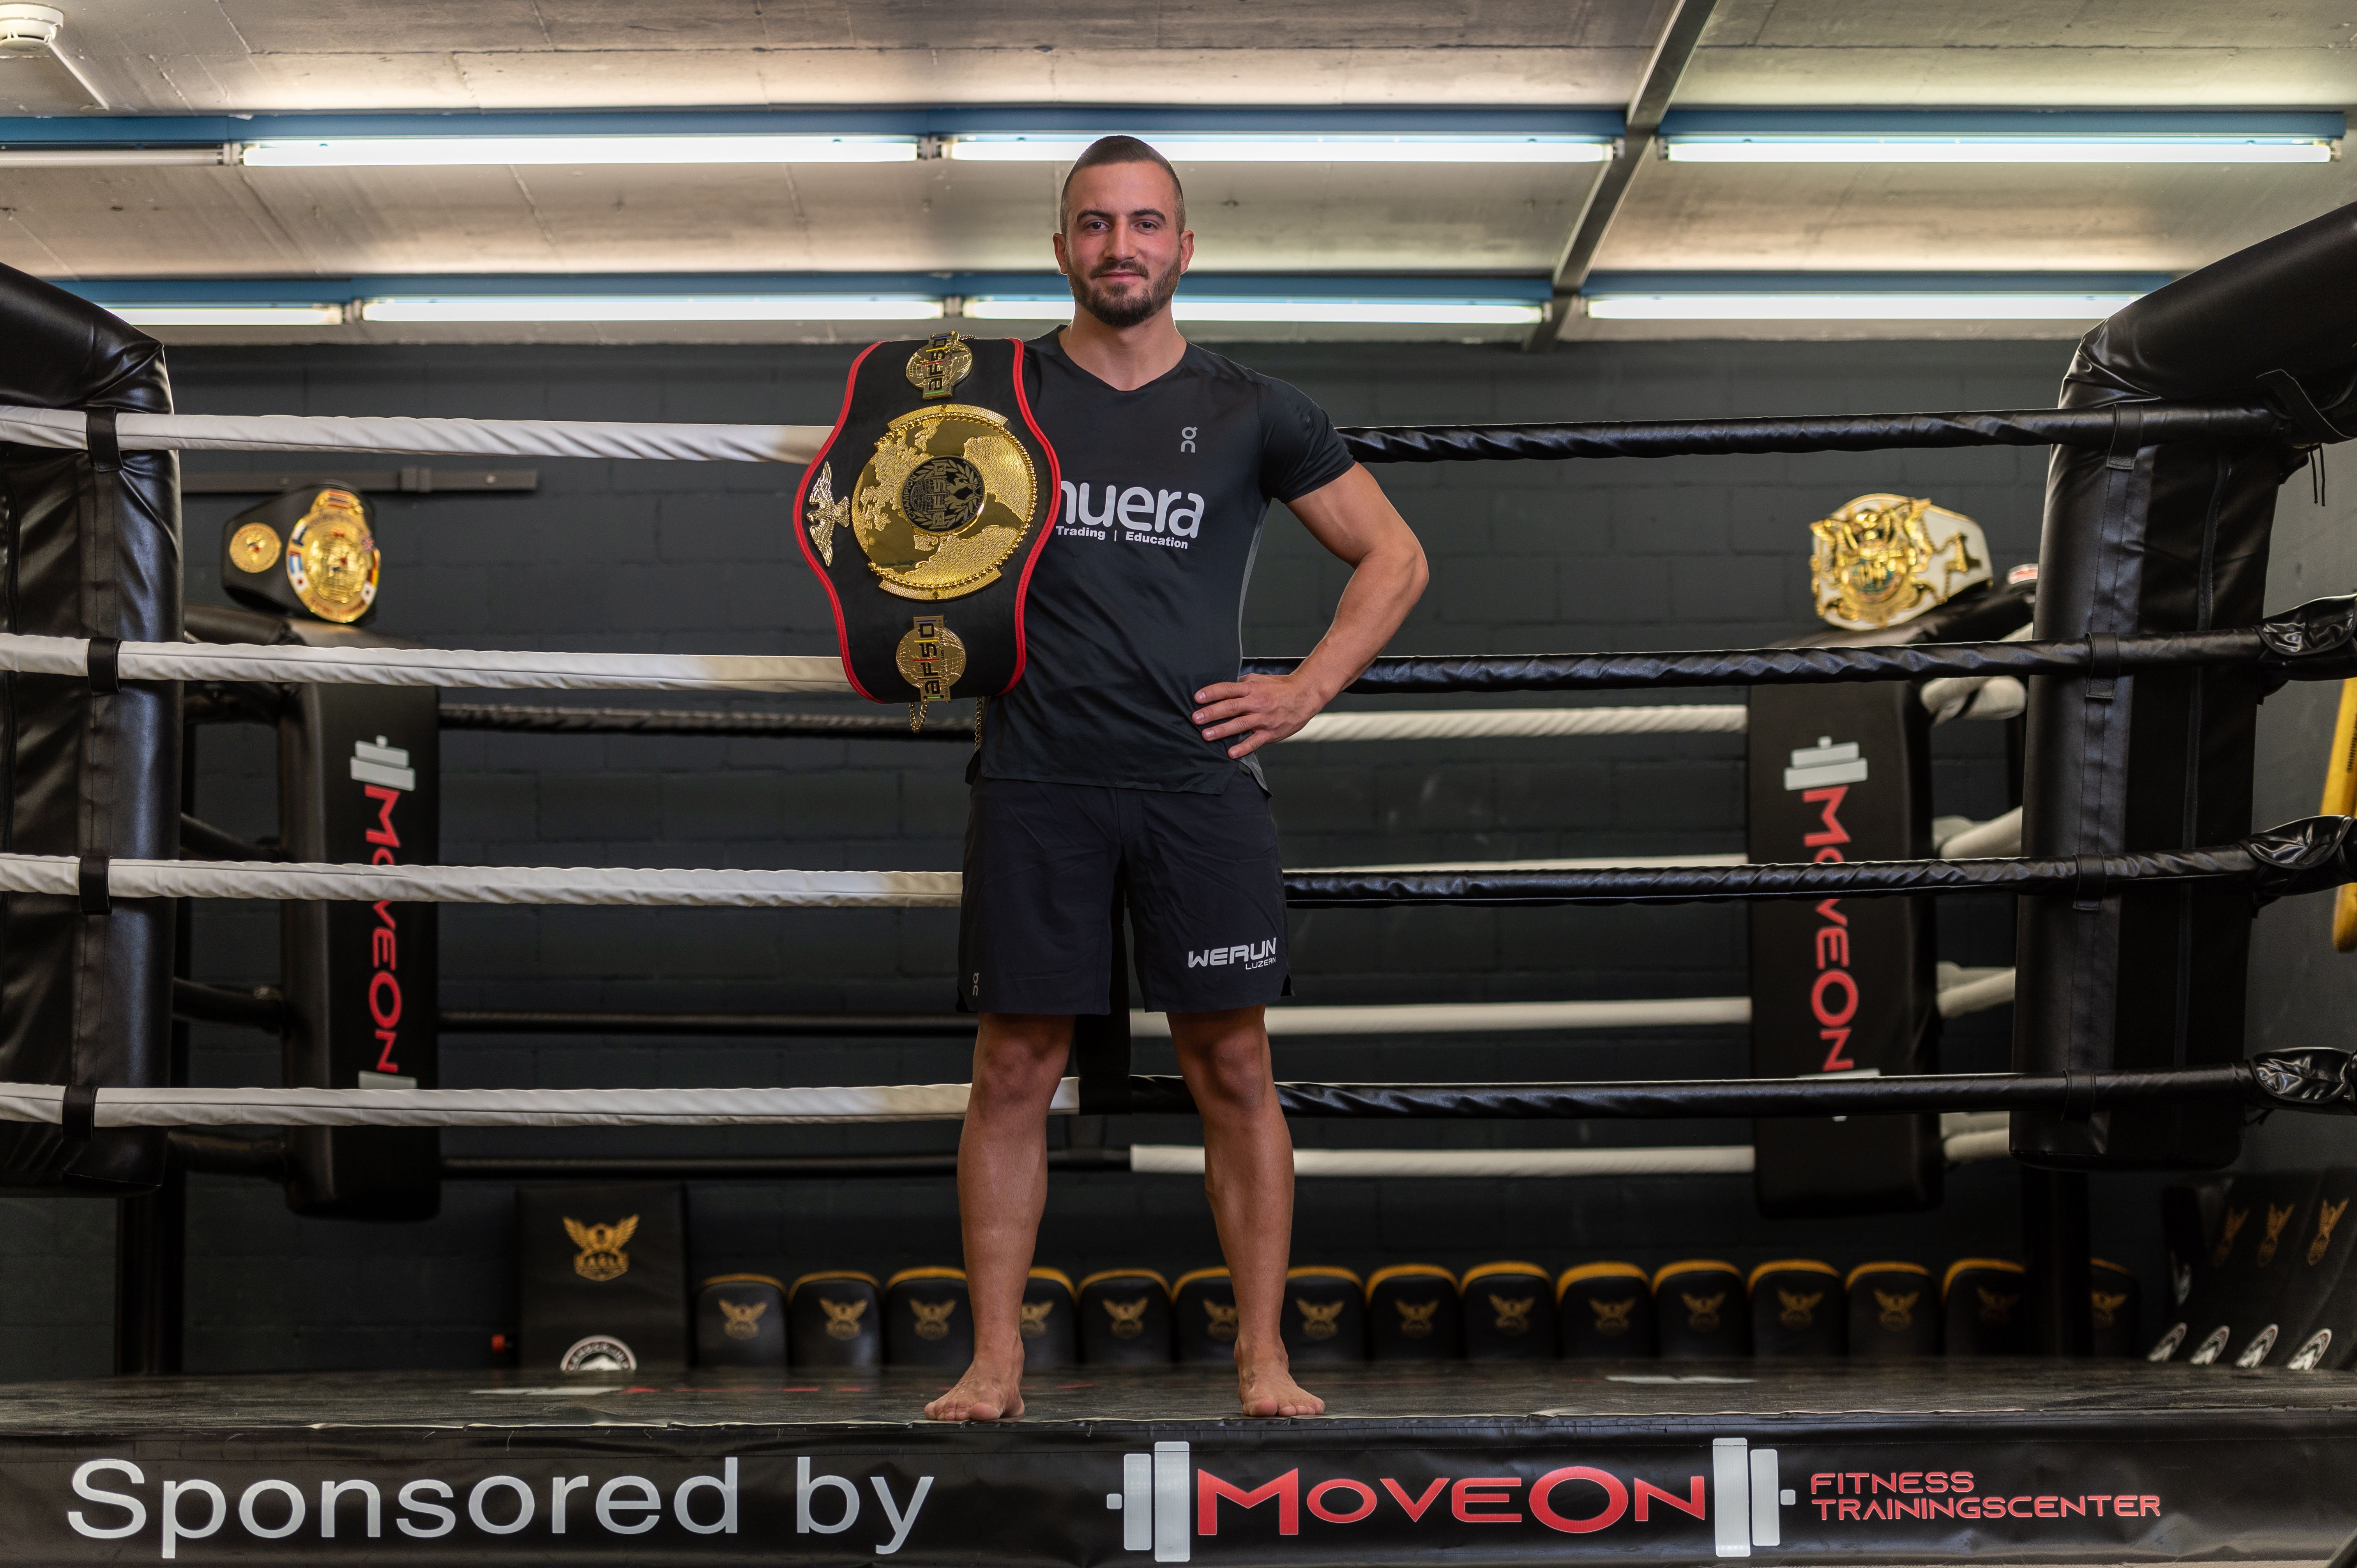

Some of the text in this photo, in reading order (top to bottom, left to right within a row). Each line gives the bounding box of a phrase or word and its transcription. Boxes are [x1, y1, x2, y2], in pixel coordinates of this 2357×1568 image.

[903, 474, 917, 519] CHAMPION
[1056, 526, 1106, 540] Trading
[1125, 531, 1188, 549] Education
[1188, 937, 1276, 968] WERUN
[1245, 957, 1276, 970] LUZERN
[1811, 1471, 1974, 1494] FITNESS
[67, 1457, 935, 1559] Sponsored by
[1811, 1495, 2161, 1520] TRAININGSCENTER
